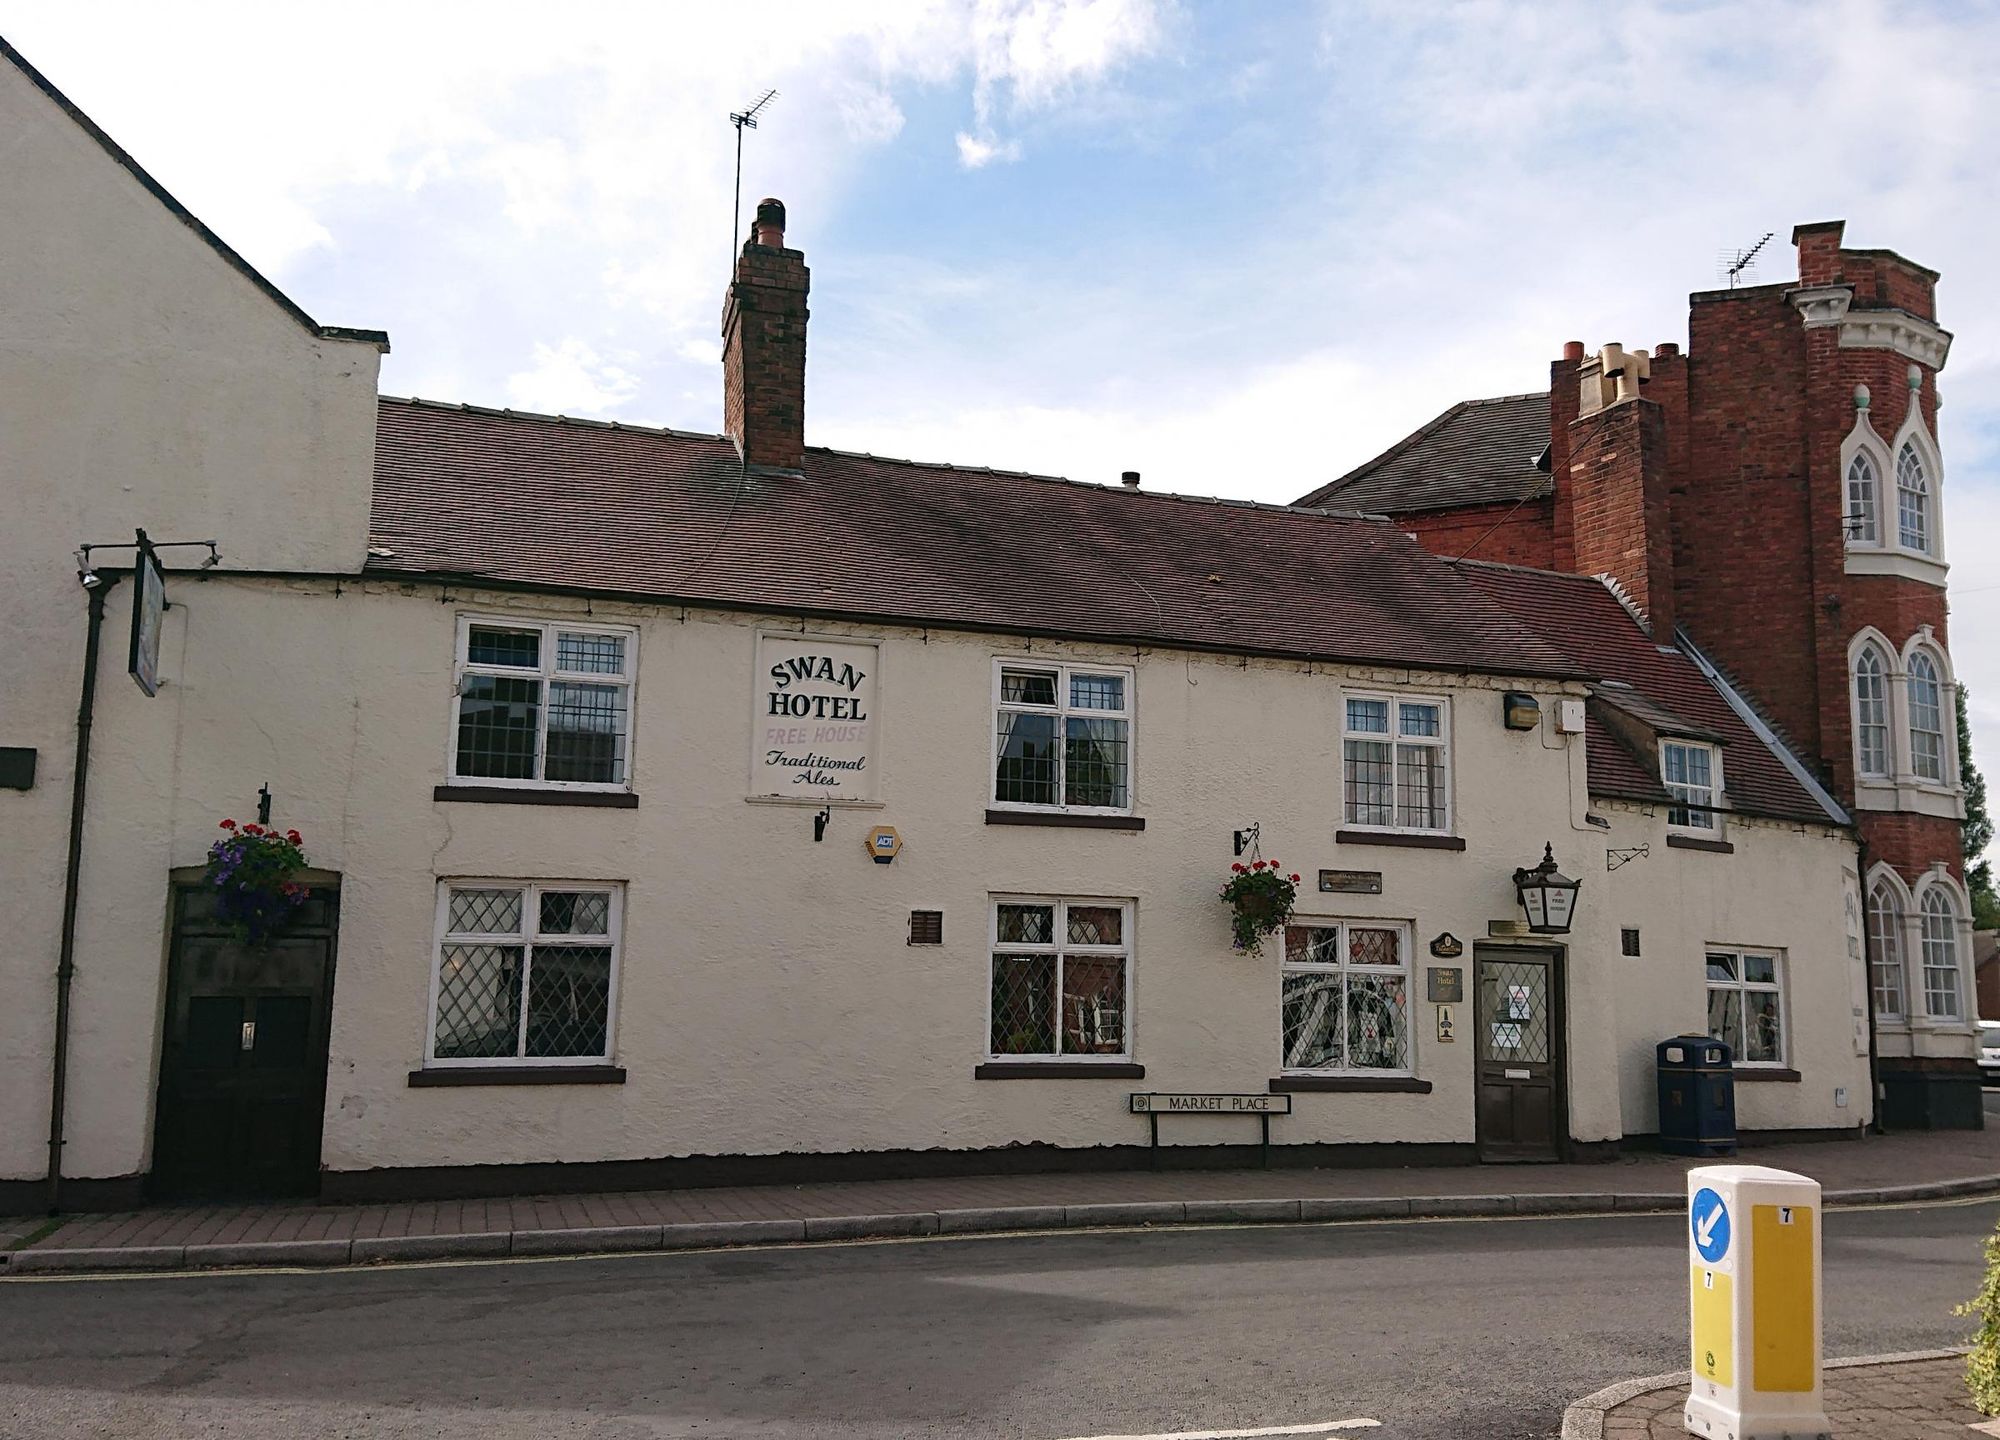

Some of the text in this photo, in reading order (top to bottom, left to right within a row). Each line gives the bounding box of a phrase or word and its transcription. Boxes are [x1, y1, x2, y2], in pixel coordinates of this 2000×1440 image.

[770, 655, 866, 692] SWAN
[768, 692, 866, 721] HOTEL
[765, 726, 868, 745] FREE HOUSE
[765, 750, 865, 771] Traditional
[793, 770, 840, 786] Ales
[877, 836, 893, 847] ADT
[1169, 1097, 1269, 1110] MARKET PLACE
[1782, 1207, 1791, 1223] 7
[1706, 1271, 1712, 1287] 7
